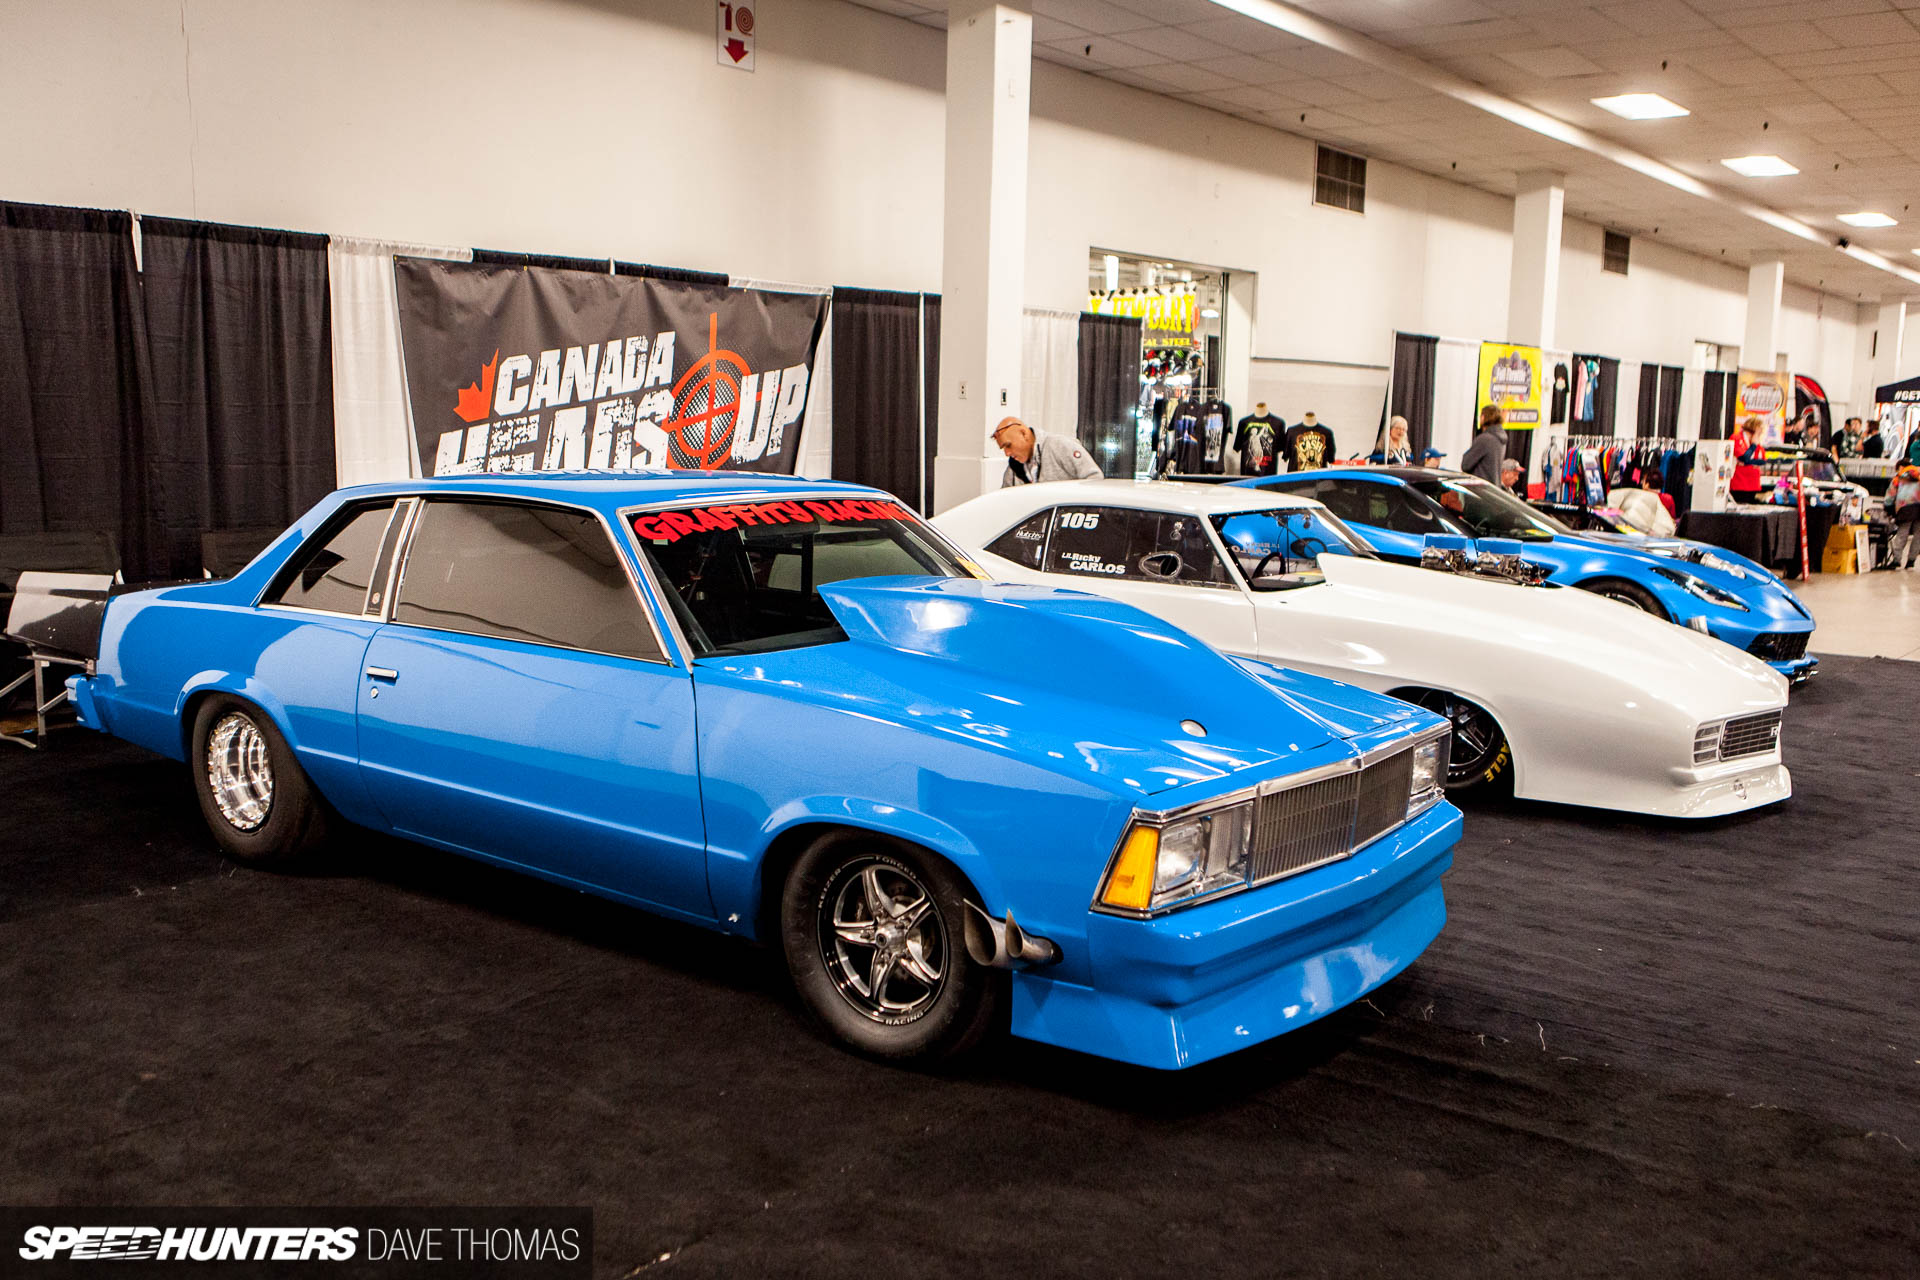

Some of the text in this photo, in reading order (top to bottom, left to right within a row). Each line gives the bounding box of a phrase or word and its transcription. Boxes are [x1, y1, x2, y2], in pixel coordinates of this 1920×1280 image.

[1112, 294, 1195, 333] JEWELRY
[1162, 338, 1192, 346] STEEL
[494, 331, 676, 417] CANADA
[433, 362, 809, 477] HEADS UP
[1299, 440, 1324, 452] CASH
[633, 499, 922, 543] GRAFFITY RACING
[1061, 512, 1099, 529] 105
[1070, 561, 1126, 574] CARLOS
[1484, 736, 1511, 782] AGLE
[875, 855, 917, 880] FORGED
[885, 1012, 924, 1026] RACING
